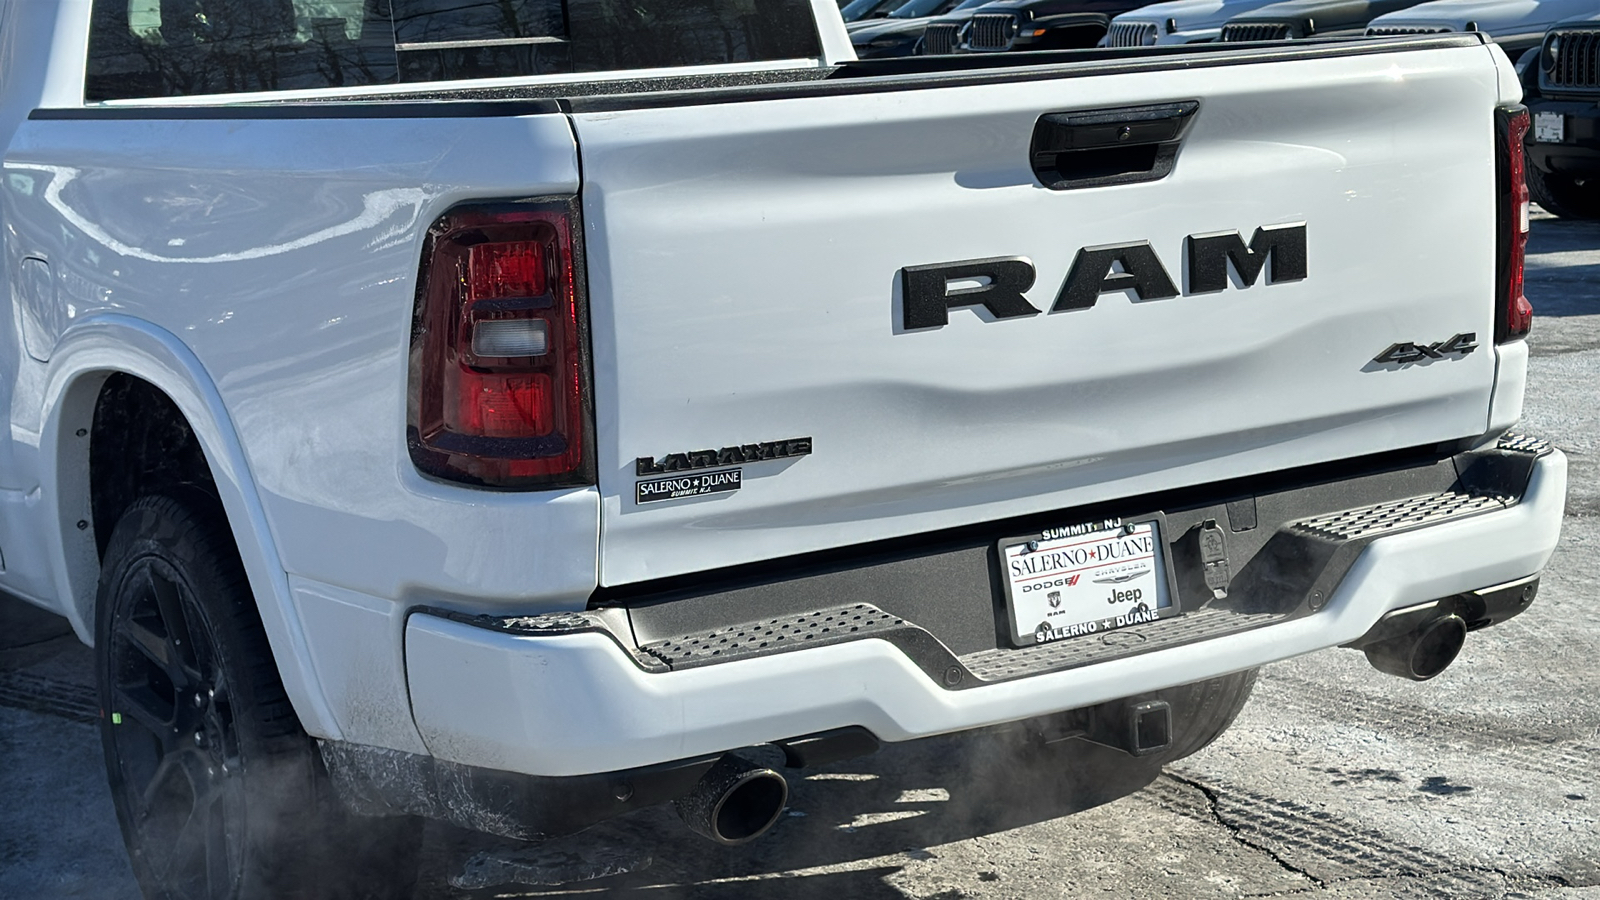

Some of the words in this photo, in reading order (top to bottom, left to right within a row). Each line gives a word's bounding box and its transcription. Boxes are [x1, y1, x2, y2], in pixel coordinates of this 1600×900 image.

[899, 220, 1308, 331] RAM
[636, 436, 812, 476] LARAMIE
[640, 478, 691, 496] SALERNO
[701, 472, 740, 487] DUANE
[1103, 517, 1122, 530] NJ
[1011, 548, 1088, 578] SALERNO
[1097, 536, 1154, 562] DUANE
[1095, 562, 1147, 577] CHRYSLER
[1022, 577, 1073, 593] DODGE
[1107, 588, 1142, 605] Jeep
[1047, 609, 1066, 617] RAM
[1036, 622, 1097, 643] SALERNO
[1116, 609, 1159, 627] DUANE
